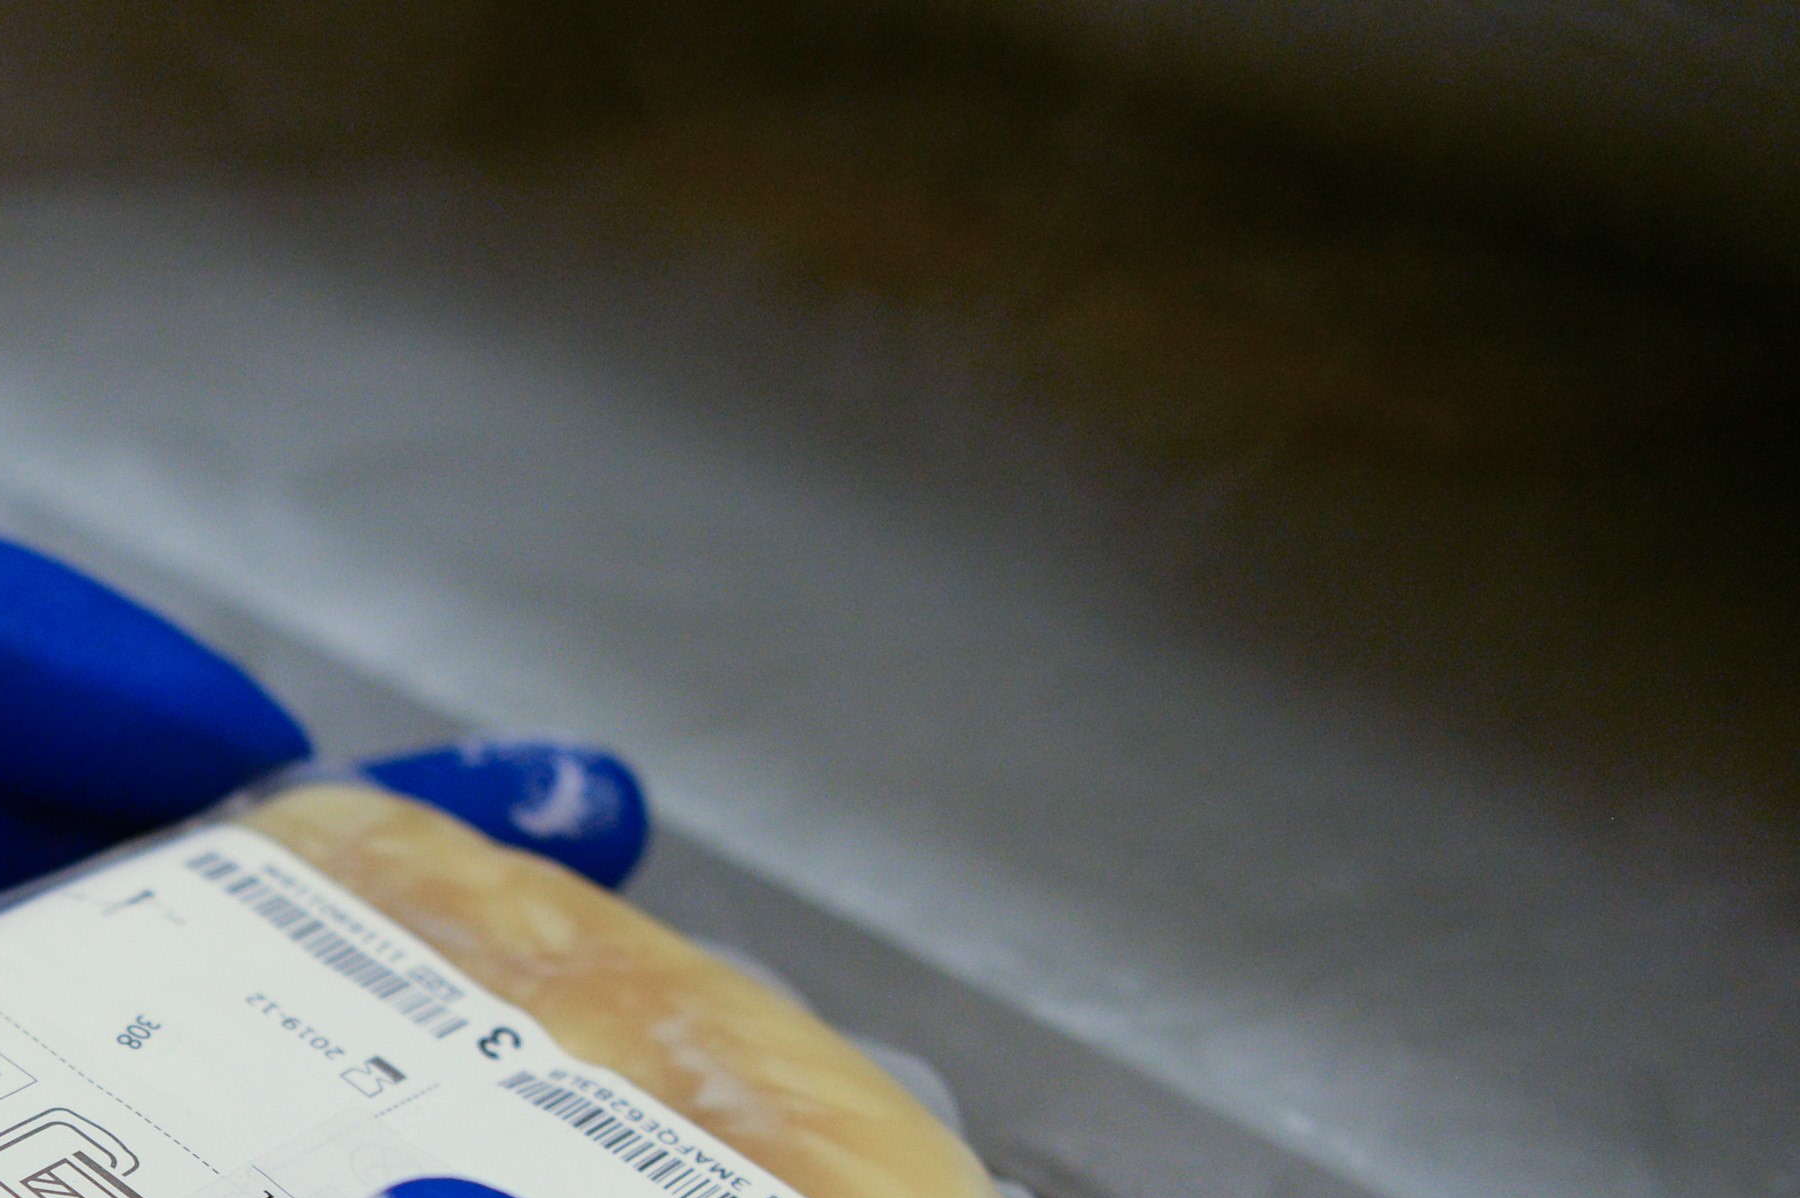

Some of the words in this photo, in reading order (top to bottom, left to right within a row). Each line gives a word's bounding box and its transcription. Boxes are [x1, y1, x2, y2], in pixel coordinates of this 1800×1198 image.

[116, 1014, 162, 1050] 308
[245, 992, 345, 1061] 2019-12
[476, 1026, 522, 1061] 3
